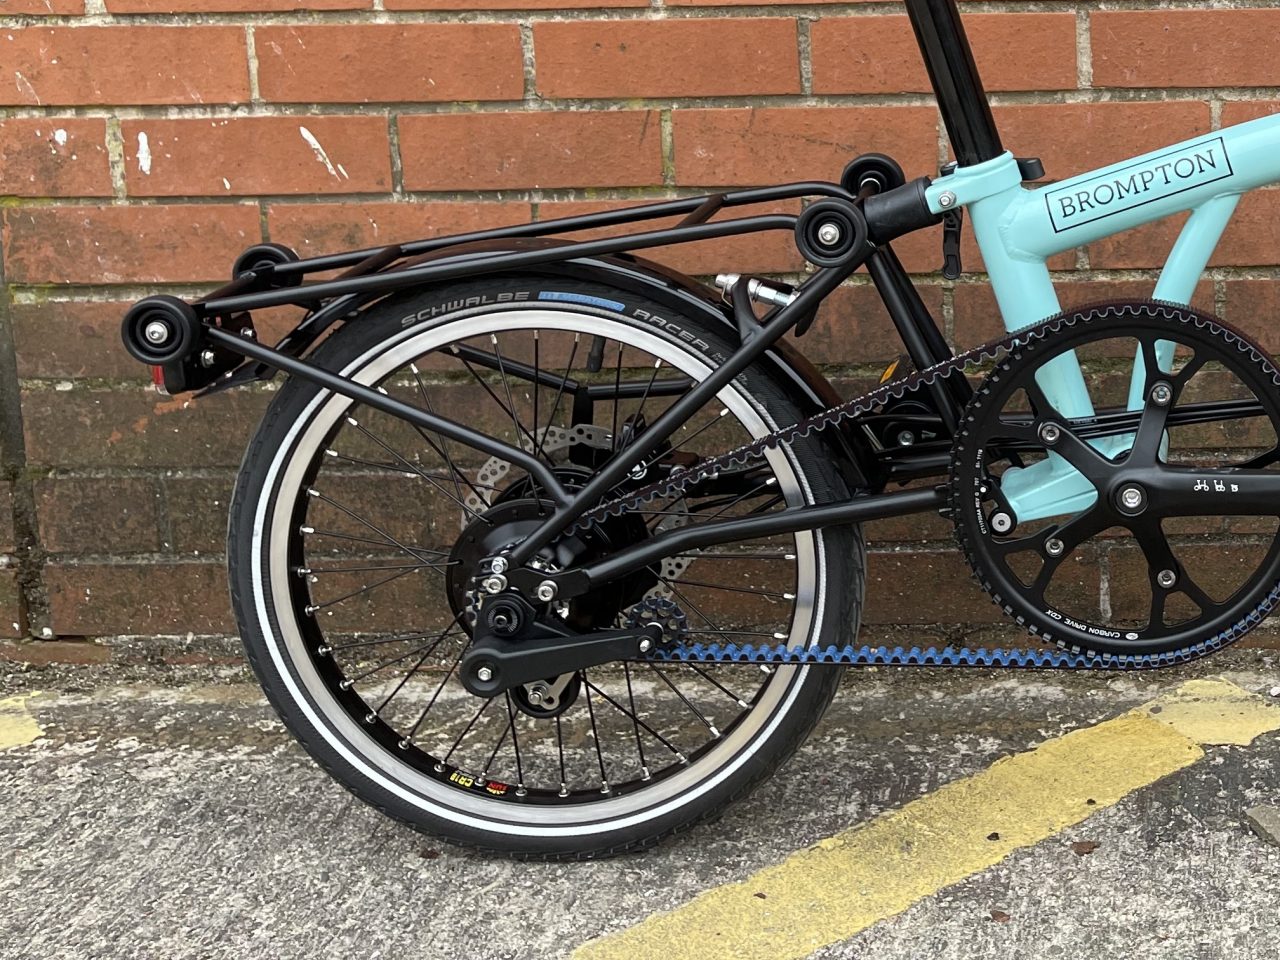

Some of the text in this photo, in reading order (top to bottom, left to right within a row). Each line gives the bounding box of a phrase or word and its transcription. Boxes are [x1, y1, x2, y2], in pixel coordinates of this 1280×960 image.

[1058, 149, 1217, 218] BROMPTON
[401, 291, 530, 327] SCHWALBE
[632, 308, 710, 352] RACER
[1045, 609, 1120, 638] CARBON DRIVE CDX
